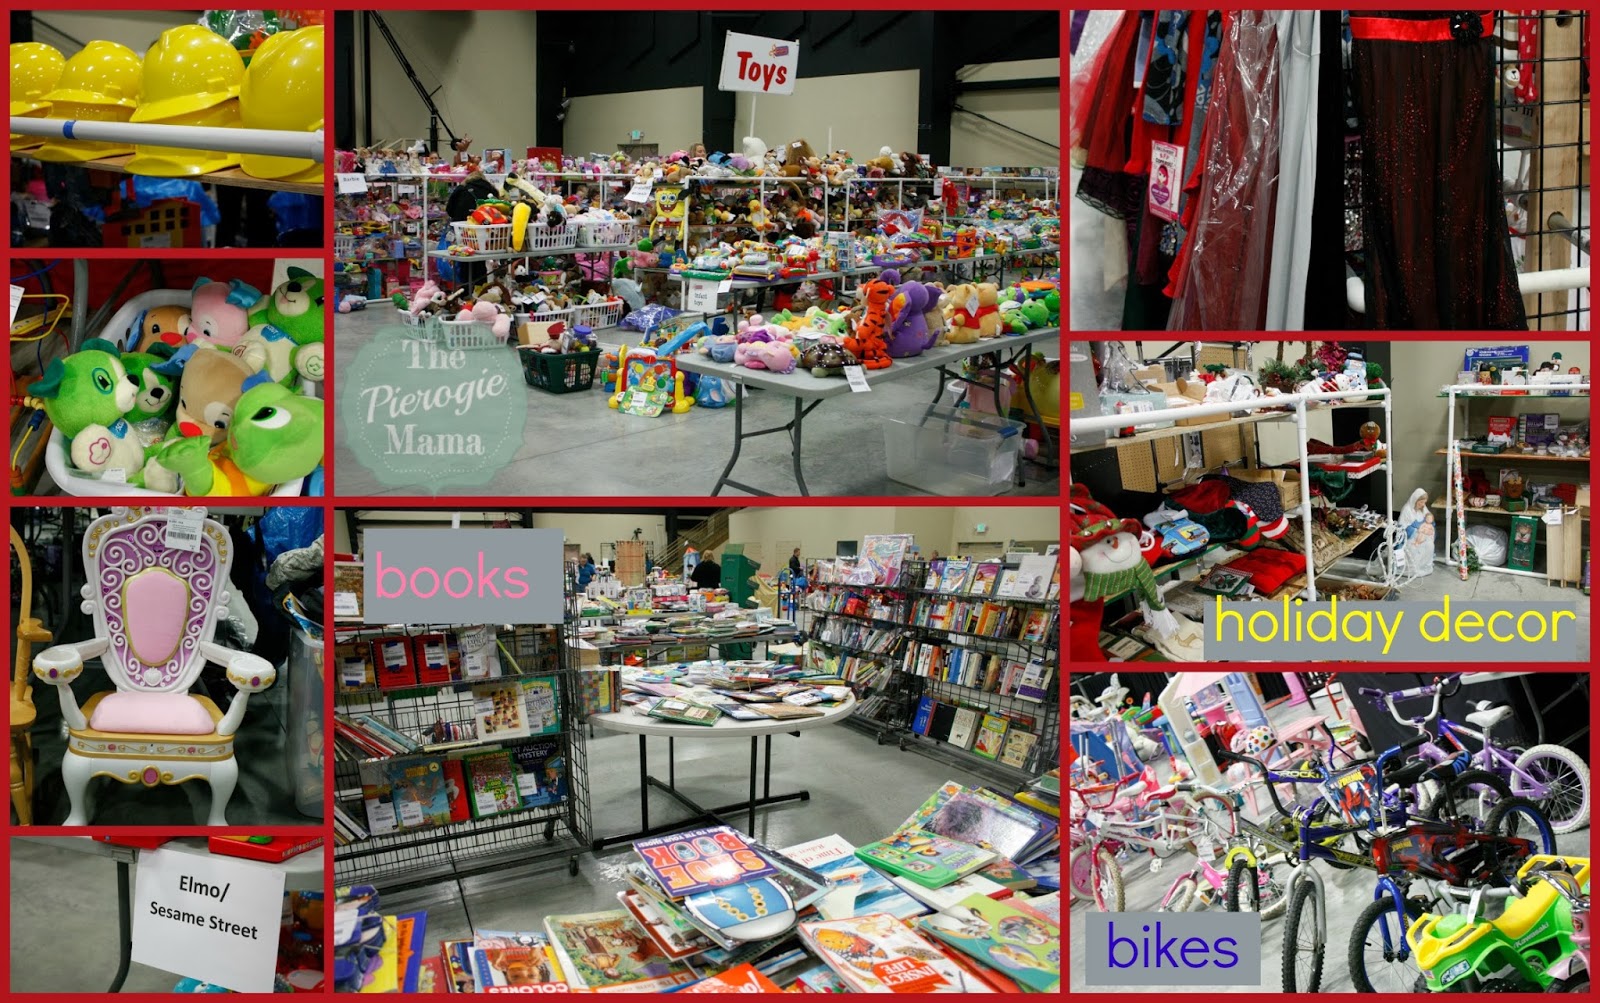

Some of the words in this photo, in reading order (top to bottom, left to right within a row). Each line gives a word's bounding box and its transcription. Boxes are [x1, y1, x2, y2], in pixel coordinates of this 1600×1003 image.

[737, 51, 787, 91] Toys
[517, 750, 549, 760] MYSTERY
[523, 742, 557, 752] AUCTION
[663, 833, 684, 843] YOUR
[642, 833, 747, 868] BOOK
[816, 847, 843, 860] Time
[179, 875, 231, 903] Elmo/
[150, 901, 205, 926] Sesame
[209, 915, 258, 940] Street
[883, 965, 937, 986] INSECT
[884, 960, 916, 974] LIFE
